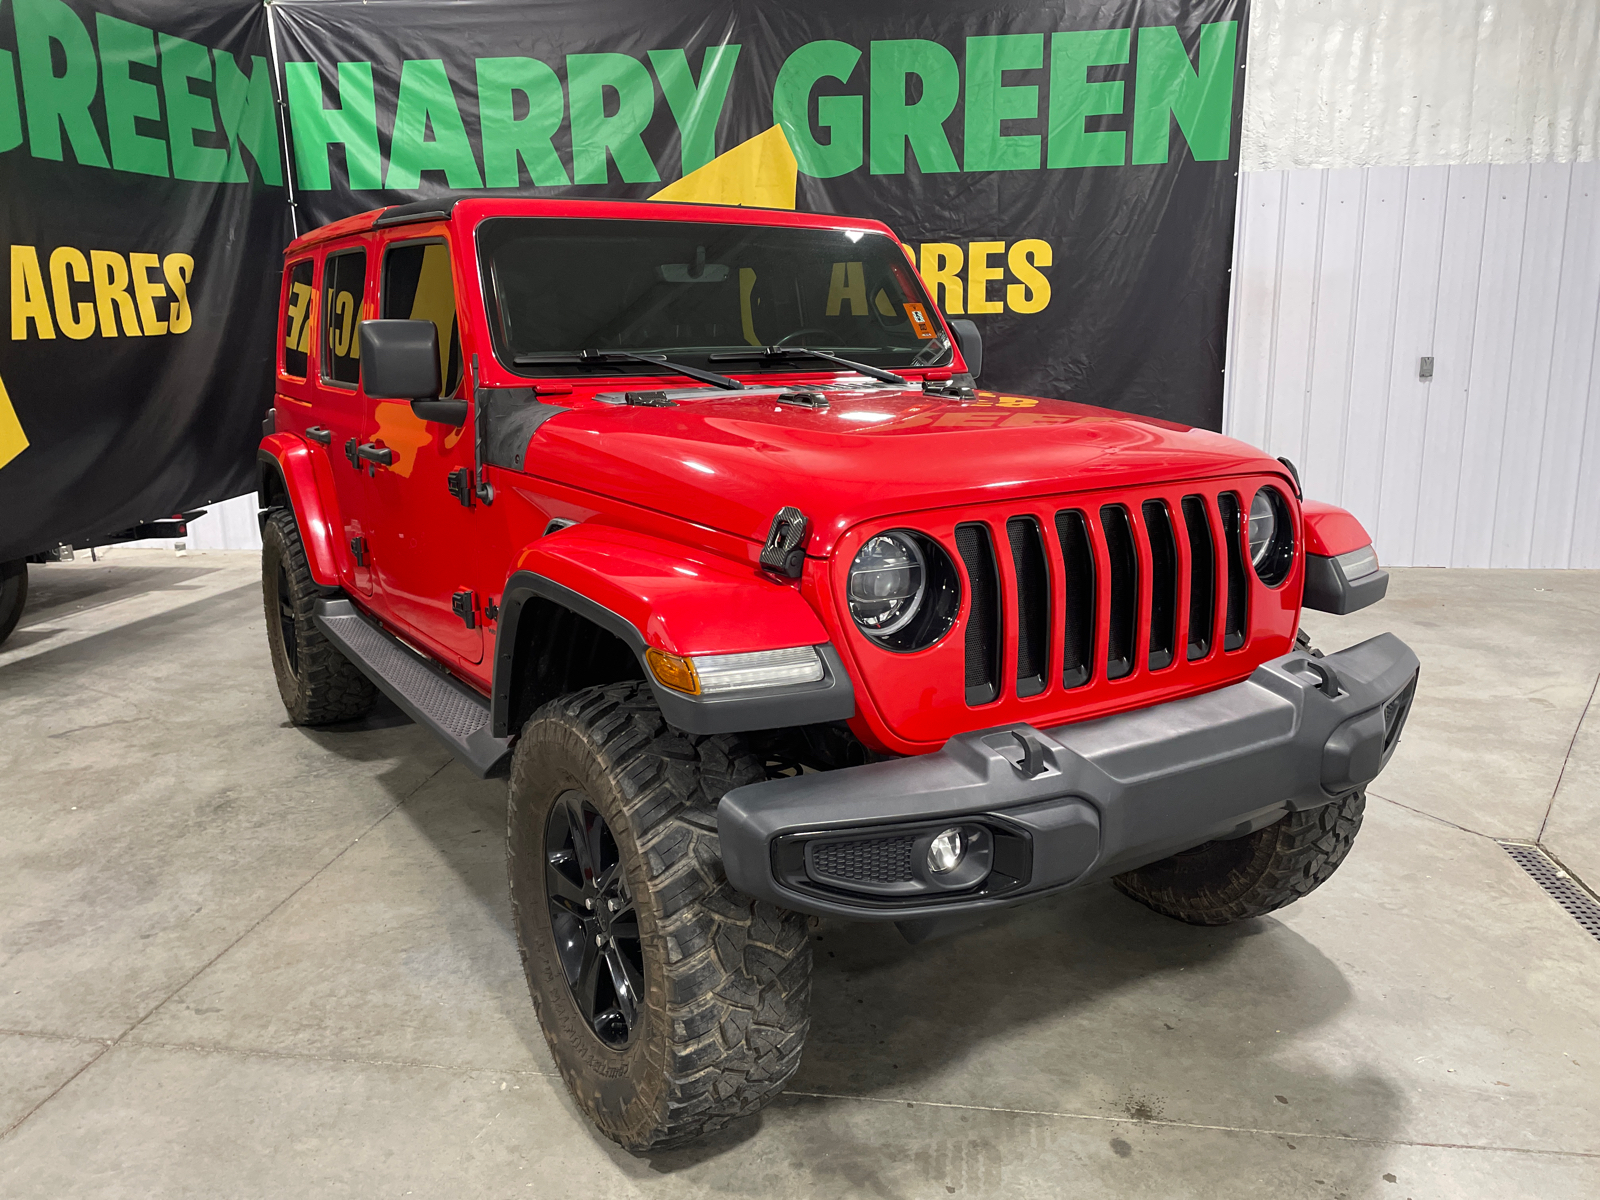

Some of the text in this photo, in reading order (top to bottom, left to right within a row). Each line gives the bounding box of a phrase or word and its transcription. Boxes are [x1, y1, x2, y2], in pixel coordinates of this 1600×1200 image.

[285, 20, 1239, 192] HARRY GREEN
[11, 244, 195, 341] ACRES
